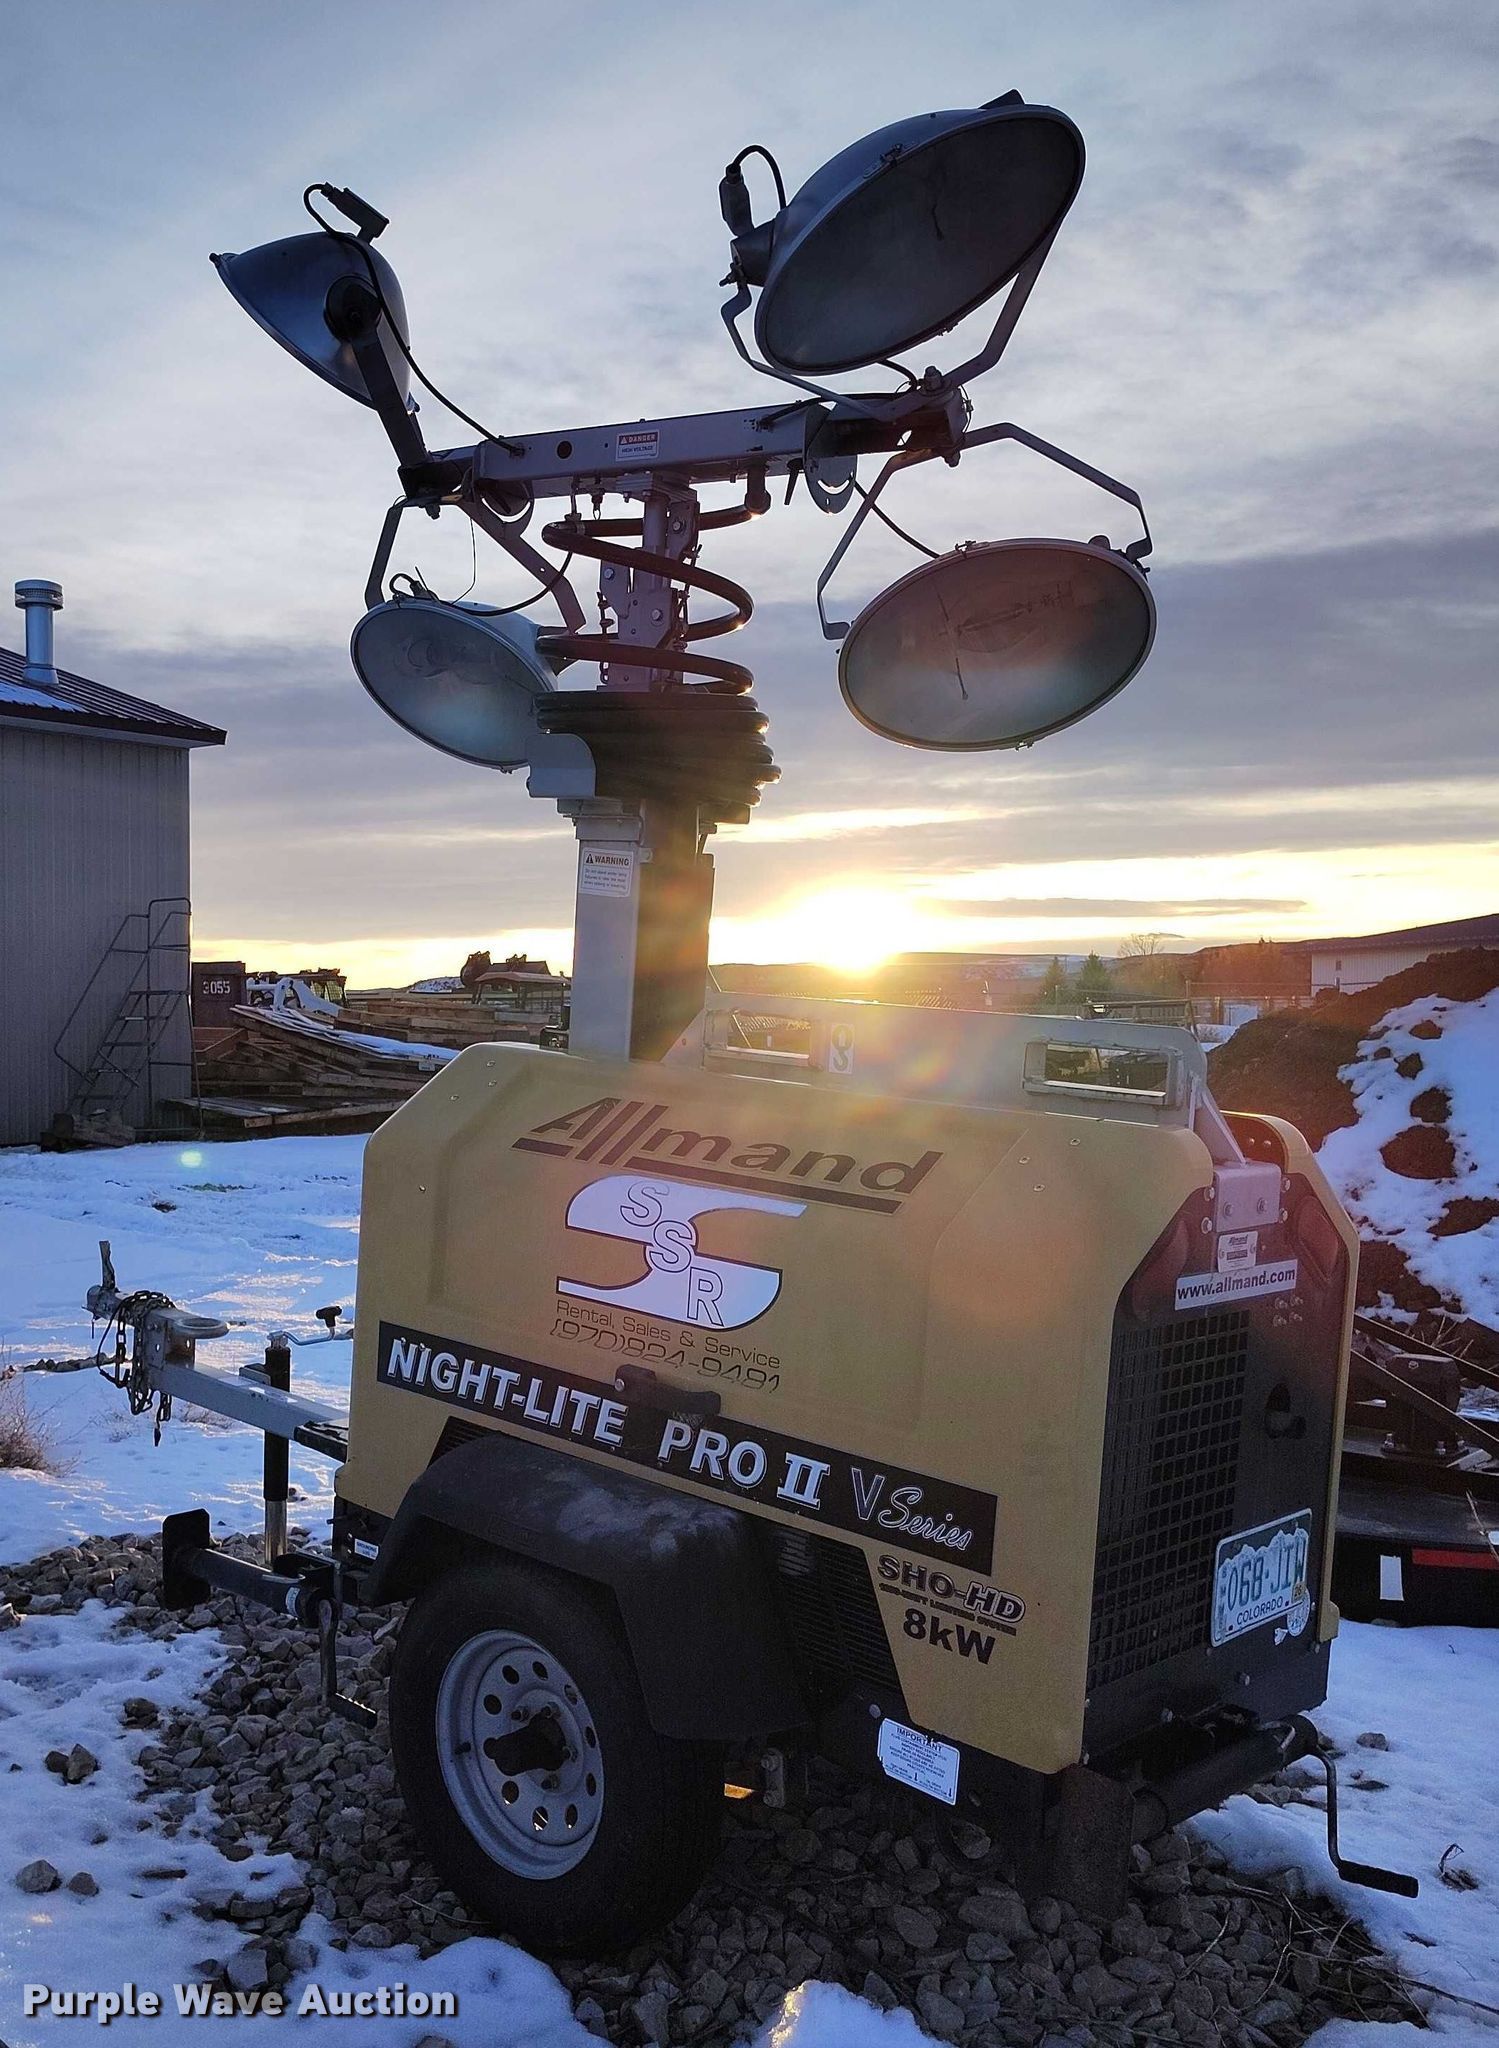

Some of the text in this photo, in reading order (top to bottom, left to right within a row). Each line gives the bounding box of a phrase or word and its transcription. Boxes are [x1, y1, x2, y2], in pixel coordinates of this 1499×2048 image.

[594, 855, 630, 866] WARNING
[203, 980, 231, 994] 3055
[531, 1096, 944, 1194] Allmand
[1177, 1267, 1296, 1300] www.allmand.com
[622, 1316, 671, 1342] Sales
[679, 1330, 696, 1348] &
[704, 1336, 781, 1369] Service
[387, 1338, 974, 1551] NIGHT-LITE PRO II V Series
[878, 1554, 1026, 1623] SHO-HD
[1236, 1596, 1283, 1625] COLORADO
[903, 1608, 996, 1665] 8kW
[896, 1726, 943, 1752] IMPORTANT
